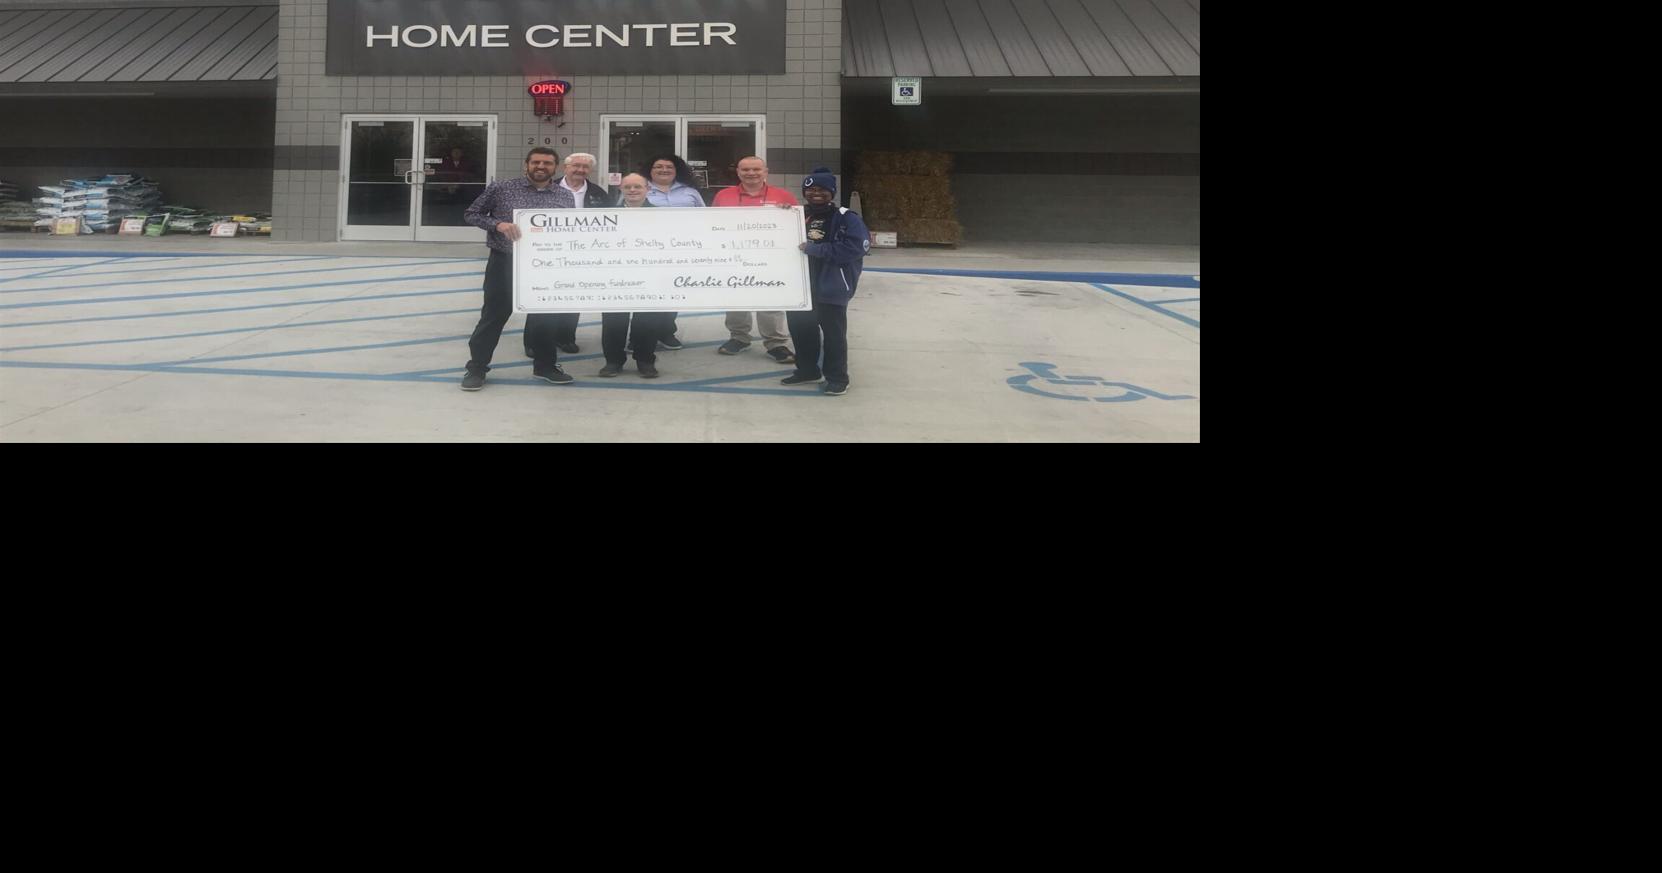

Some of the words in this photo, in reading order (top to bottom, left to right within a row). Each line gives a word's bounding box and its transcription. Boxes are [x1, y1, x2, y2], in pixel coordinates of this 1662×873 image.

[366, 24, 510, 48] HOME
[525, 22, 738, 48] CENTER
[531, 84, 565, 94] OPEN
[530, 213, 618, 228] GILLMAN
[566, 239, 587, 251] The
[591, 238, 611, 249] Arc
[616, 238, 628, 248] of
[634, 238, 665, 249] Shelby
[670, 238, 703, 249] County
[532, 257, 555, 268] One
[556, 256, 603, 267] Thousand
[674, 275, 722, 288] Charlie
[727, 275, 786, 289] Gillman
